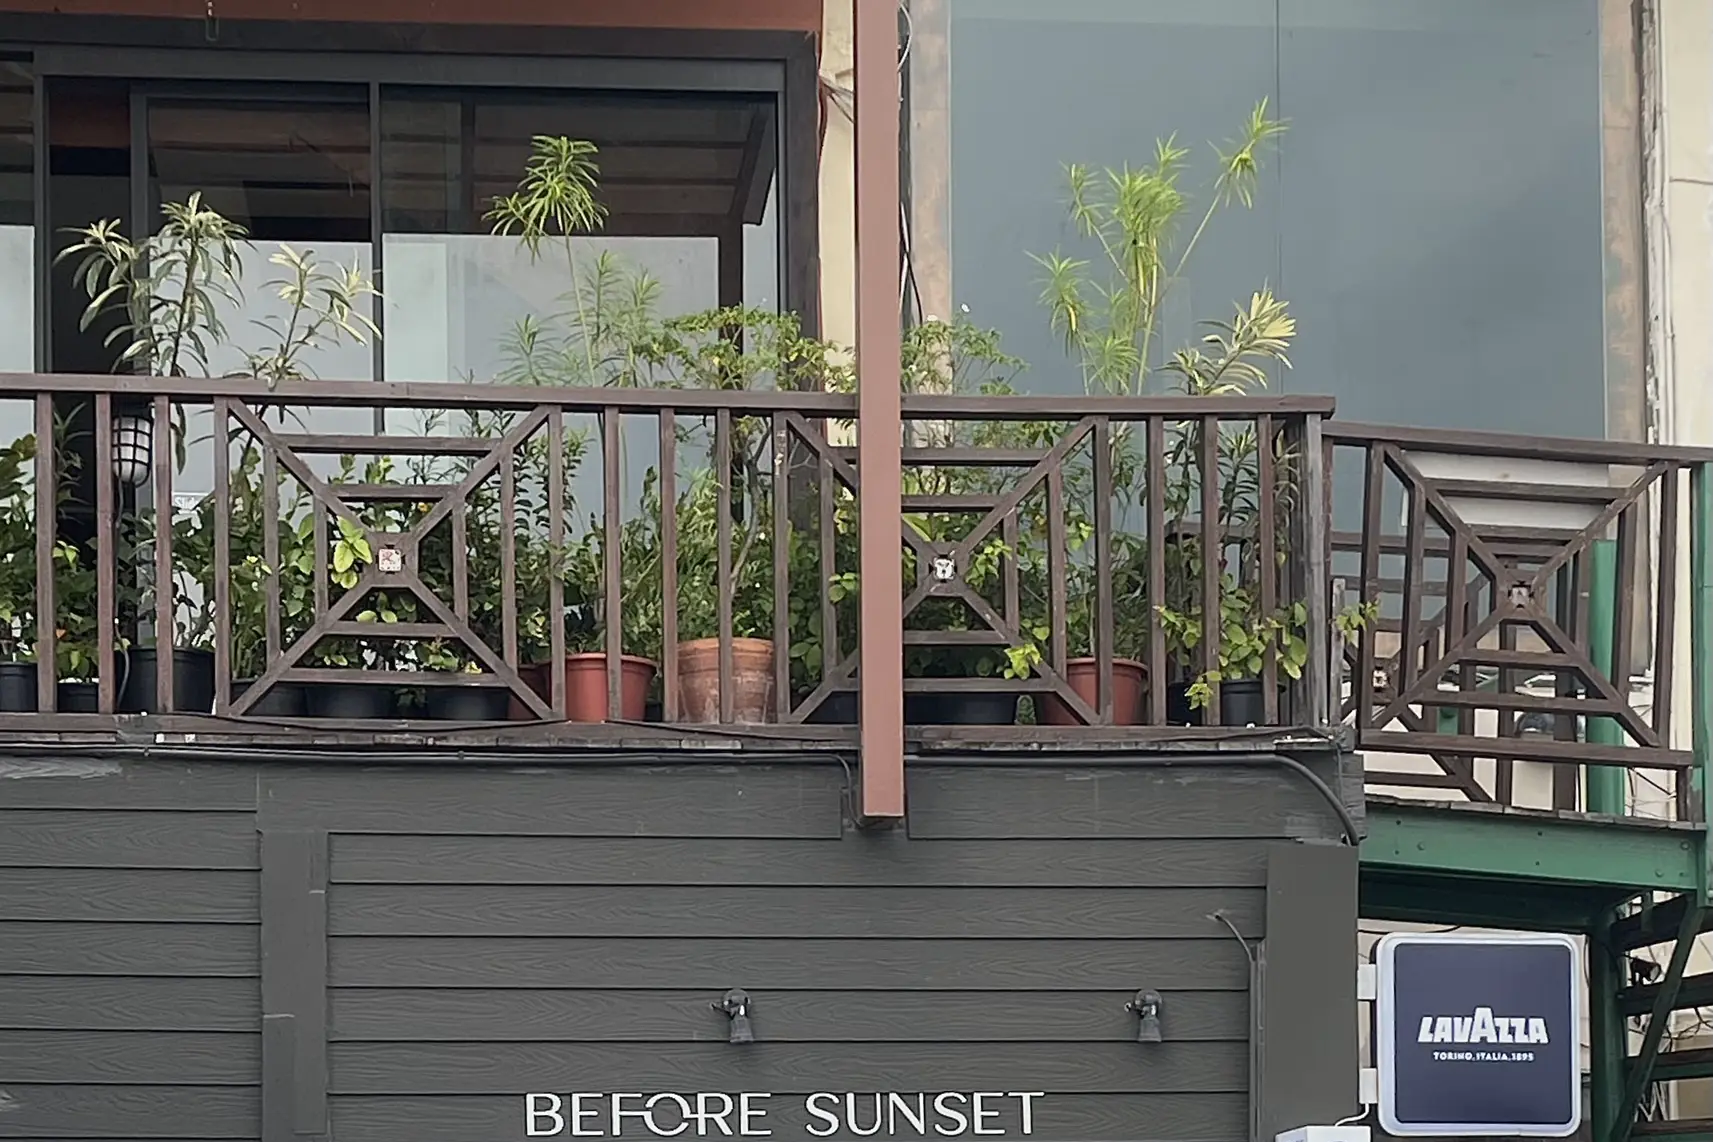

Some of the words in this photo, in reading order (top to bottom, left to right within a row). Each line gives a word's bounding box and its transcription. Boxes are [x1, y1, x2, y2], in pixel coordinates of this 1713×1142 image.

[1417, 1007, 1549, 1044] LAVAZZA
[525, 1092, 772, 1137] BEFORE
[805, 1091, 1045, 1136] SUNSET
